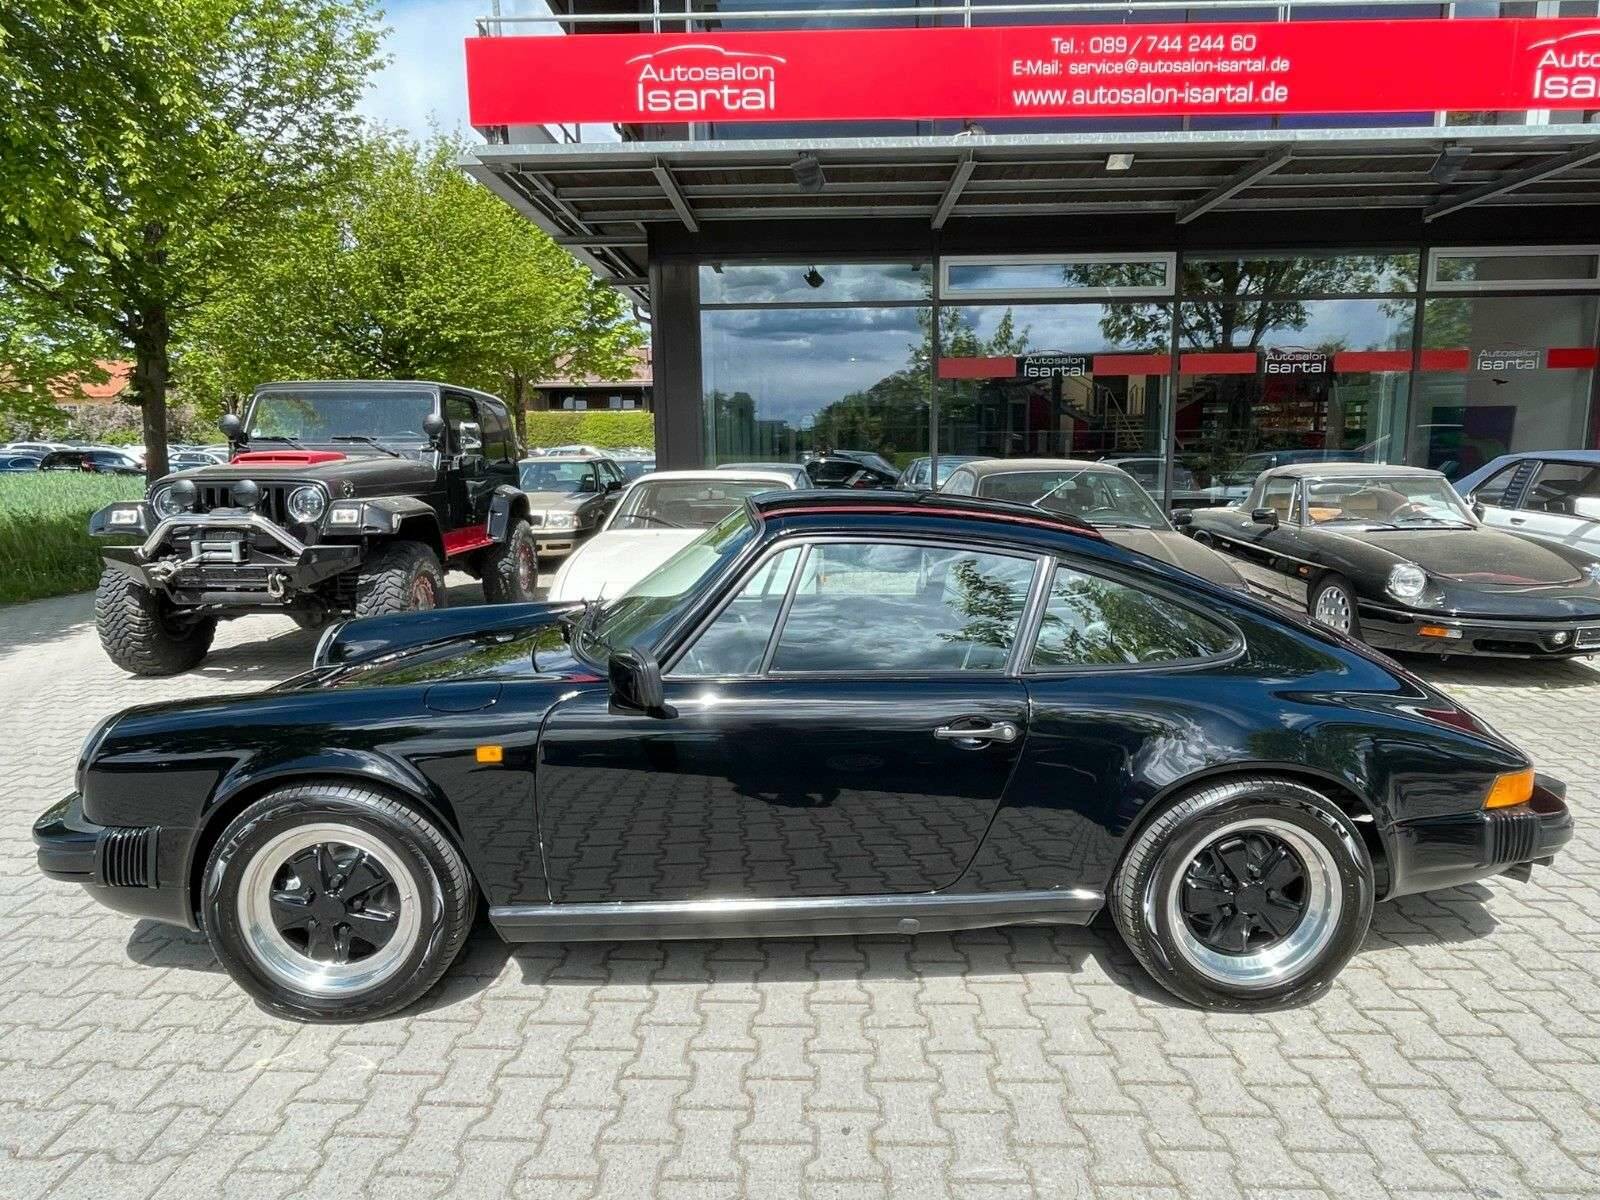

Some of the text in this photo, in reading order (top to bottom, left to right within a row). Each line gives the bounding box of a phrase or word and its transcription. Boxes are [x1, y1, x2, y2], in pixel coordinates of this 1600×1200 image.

[1052, 38, 1085, 54] Tel.:
[1089, 37, 1127, 53] 089
[1147, 36, 1182, 52] 744
[1188, 35, 1224, 52] 244
[1231, 34, 1257, 52] 60
[638, 62, 775, 83] Autosalon
[1012, 57, 1291, 76] E-Mail: service@autosalon-isartal.de
[1533, 69, 1600, 99] Isa
[637, 80, 775, 112] Isartal
[1013, 81, 1289, 106] www.autosalon-isartal.de
[1025, 356, 1086, 365] Autosalon
[1265, 352, 1326, 361] Autosalon
[1479, 349, 1540, 358] Autosalon
[1024, 363, 1086, 377] Isartal
[1264, 360, 1327, 374] Isartal
[1477, 357, 1540, 370] Isartal
